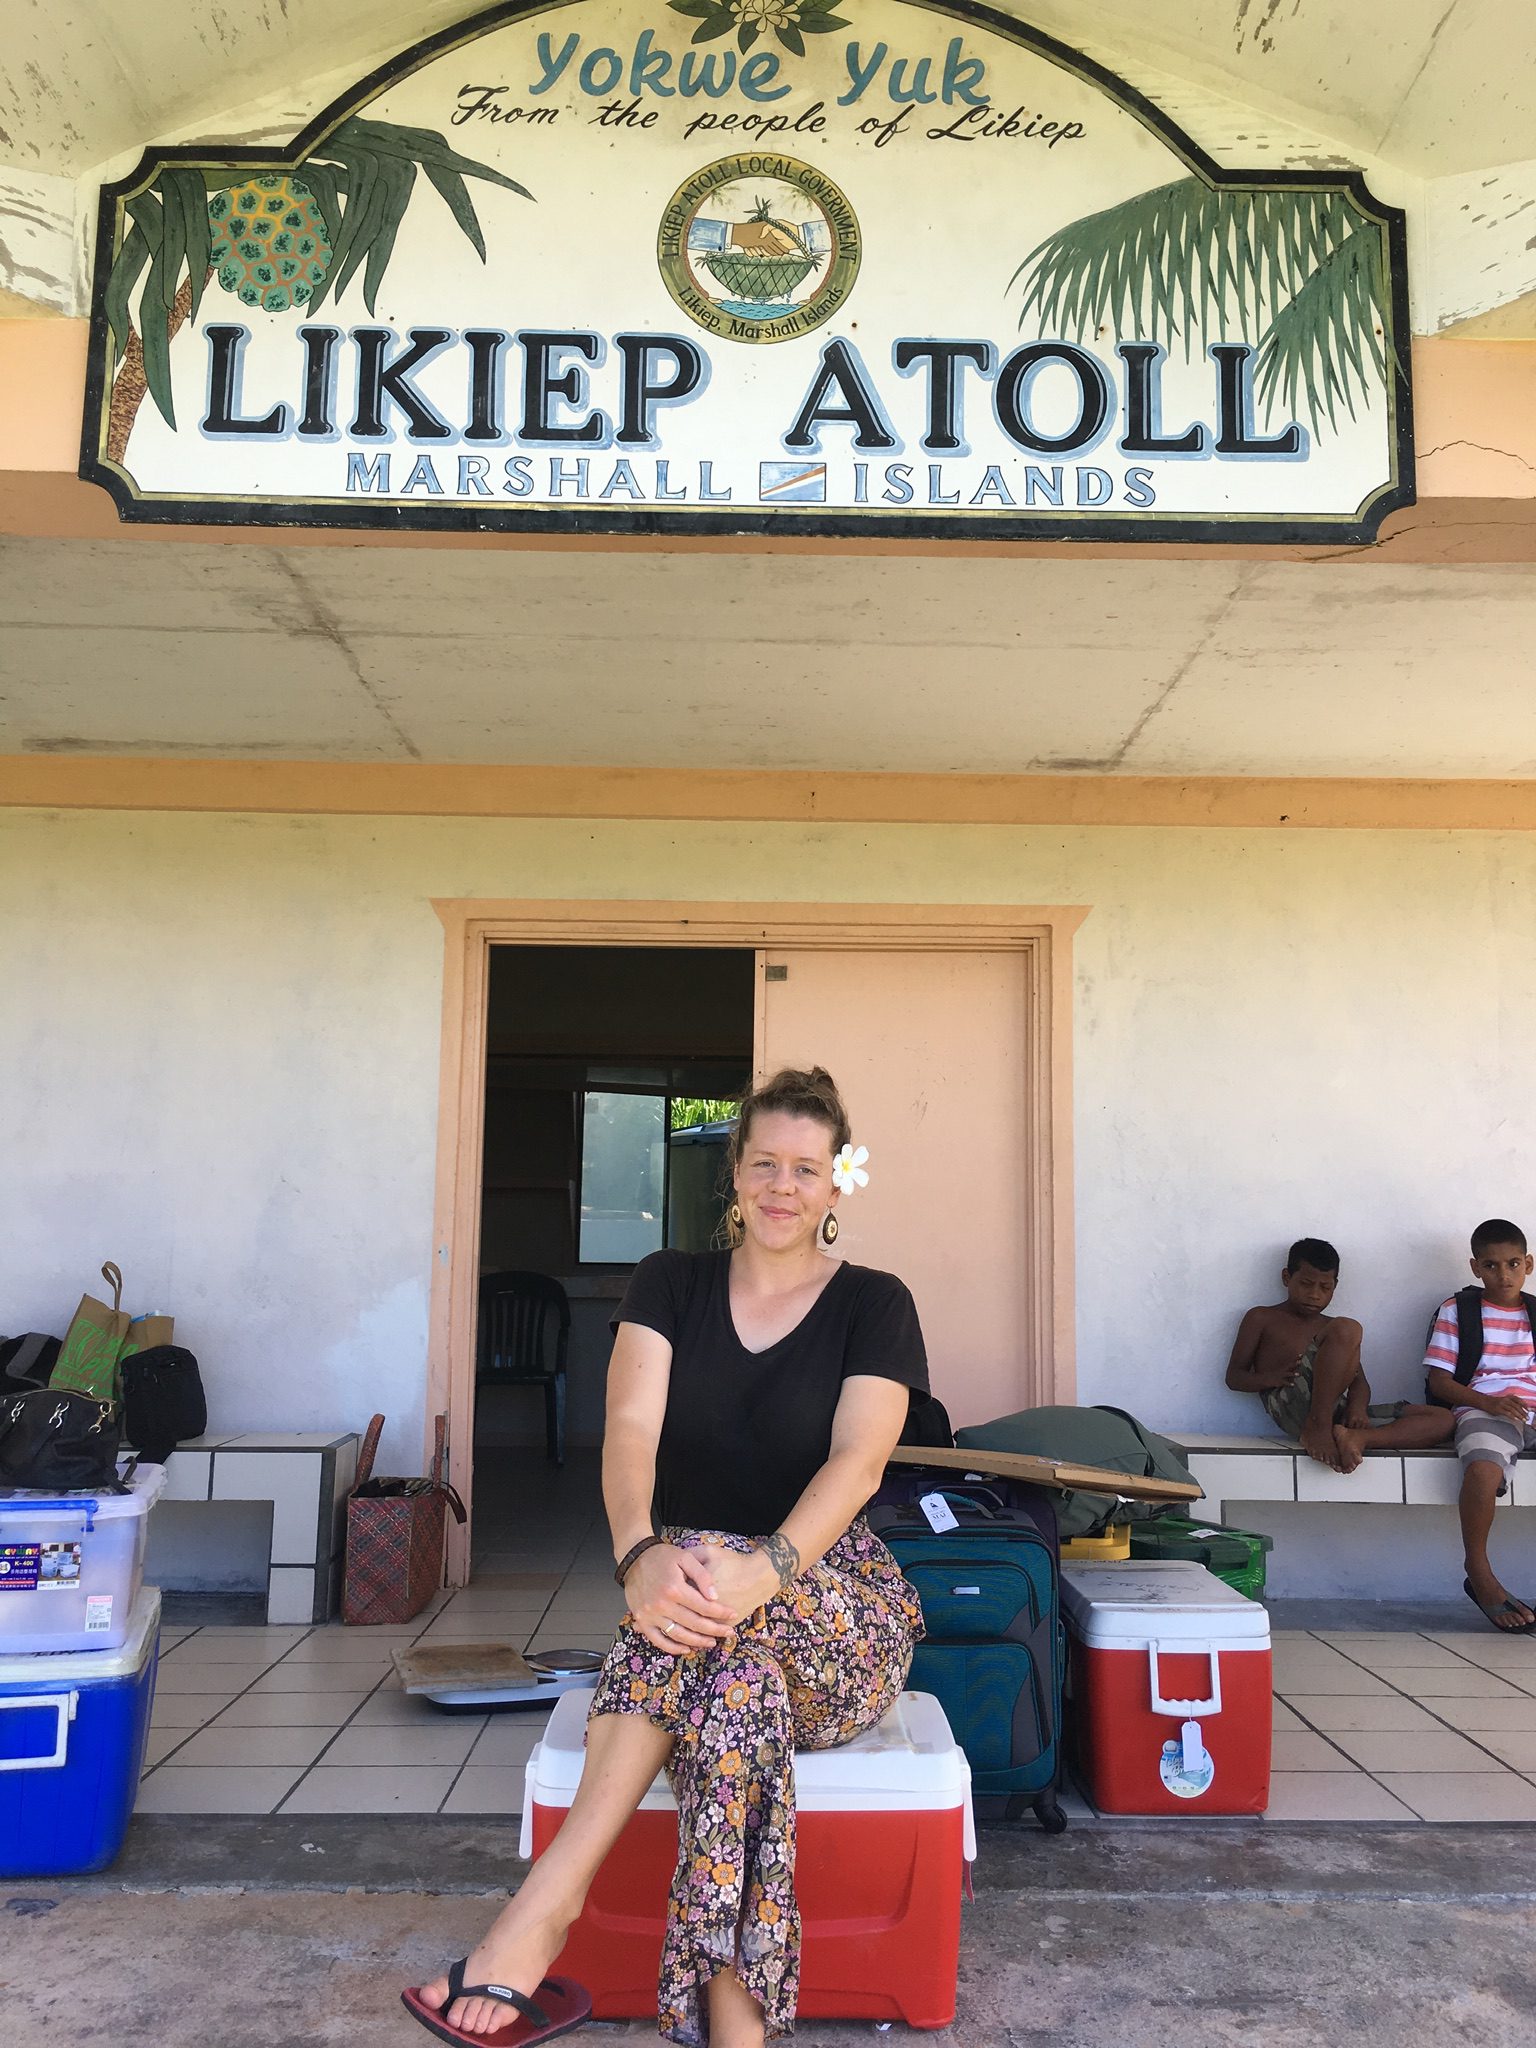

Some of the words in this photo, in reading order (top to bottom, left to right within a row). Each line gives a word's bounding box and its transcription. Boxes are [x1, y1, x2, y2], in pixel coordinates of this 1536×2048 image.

[529, 28, 793, 102] Yokwe
[837, 37, 991, 107] Yuk
[451, 83, 560, 126] From
[587, 97, 659, 128] the
[684, 101, 826, 142] people
[855, 104, 916, 148] of
[926, 105, 1087, 149] Likiep
[661, 204, 686, 258] LIKIEP
[681, 164, 732, 207] ATOLL
[736, 155, 796, 179] LOCAL
[798, 169, 859, 265] GOVERNMENT
[728, 315, 801, 339] Marshall
[800, 286, 844, 327] Islands
[200, 324, 707, 448] LIKIEP
[782, 338, 1305, 459] ATOLL
[346, 452, 732, 501] MARSHALL
[853, 462, 1157, 508] ISLANDS
